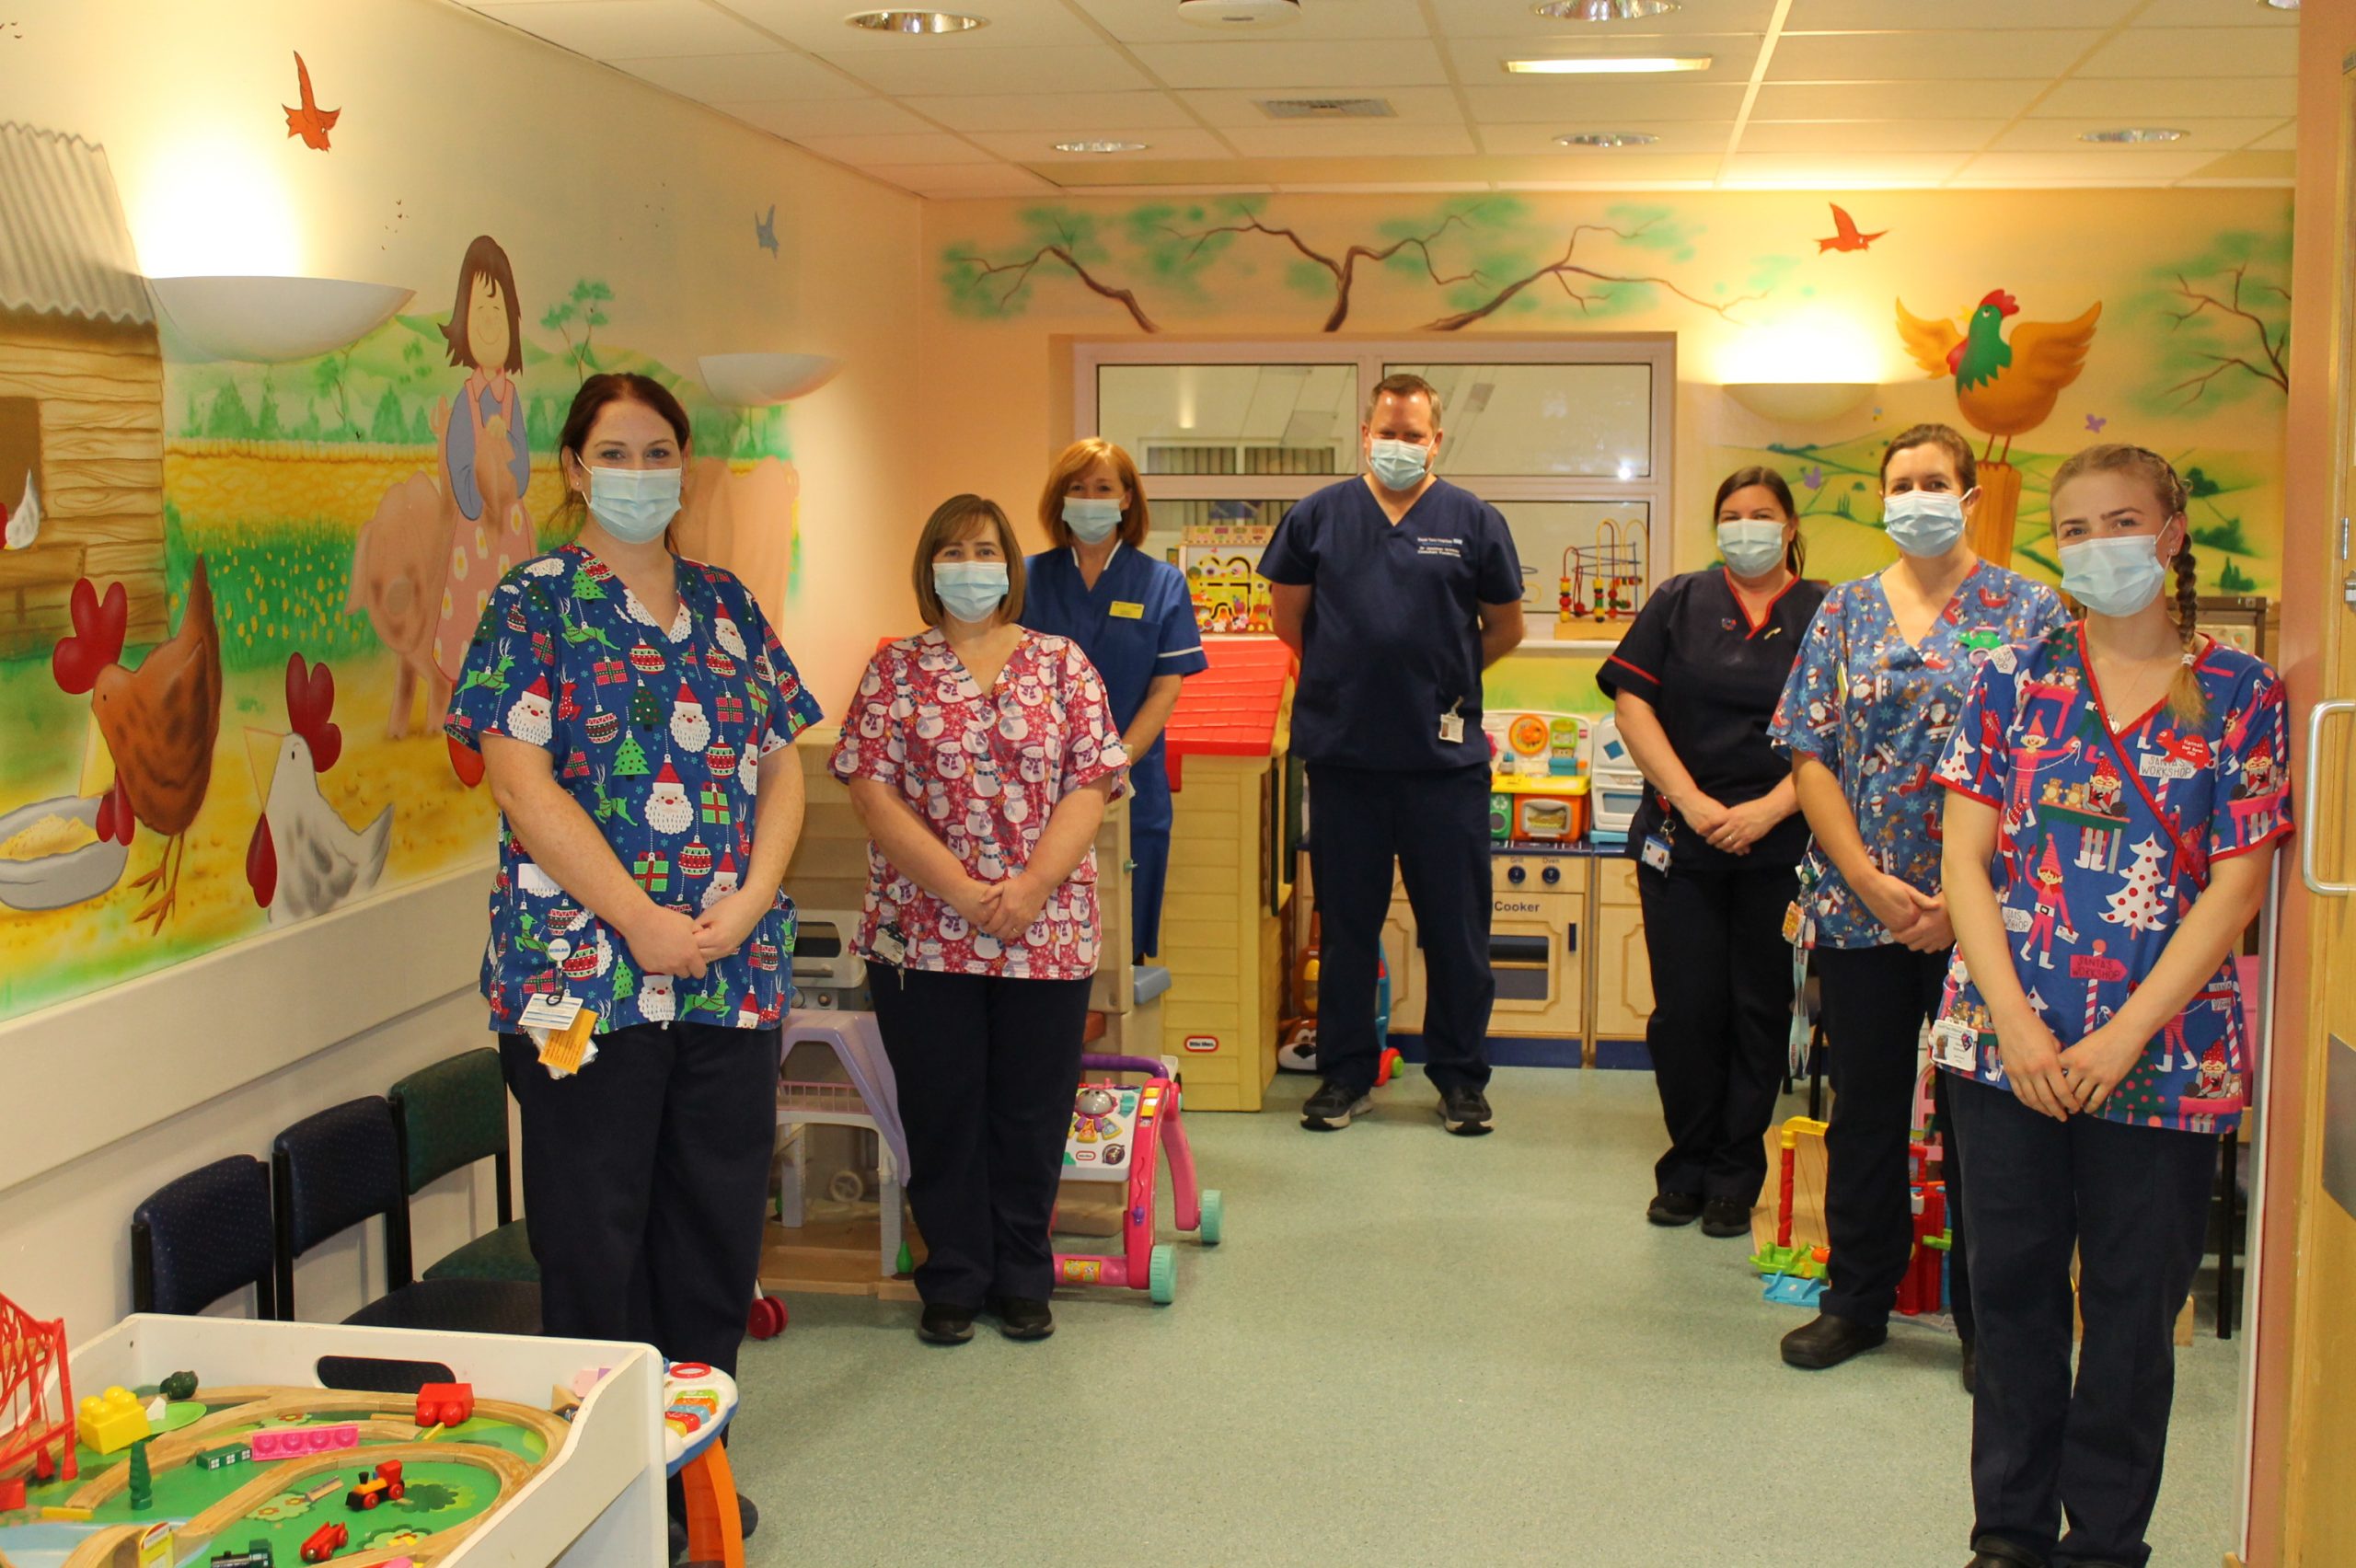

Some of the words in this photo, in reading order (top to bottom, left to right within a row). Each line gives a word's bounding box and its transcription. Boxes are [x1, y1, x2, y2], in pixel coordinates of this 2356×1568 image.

[2183, 739, 2203, 748] Hannah
[2142, 765, 2191, 778] WORKSHOP
[1494, 901, 1540, 913] Cooker
